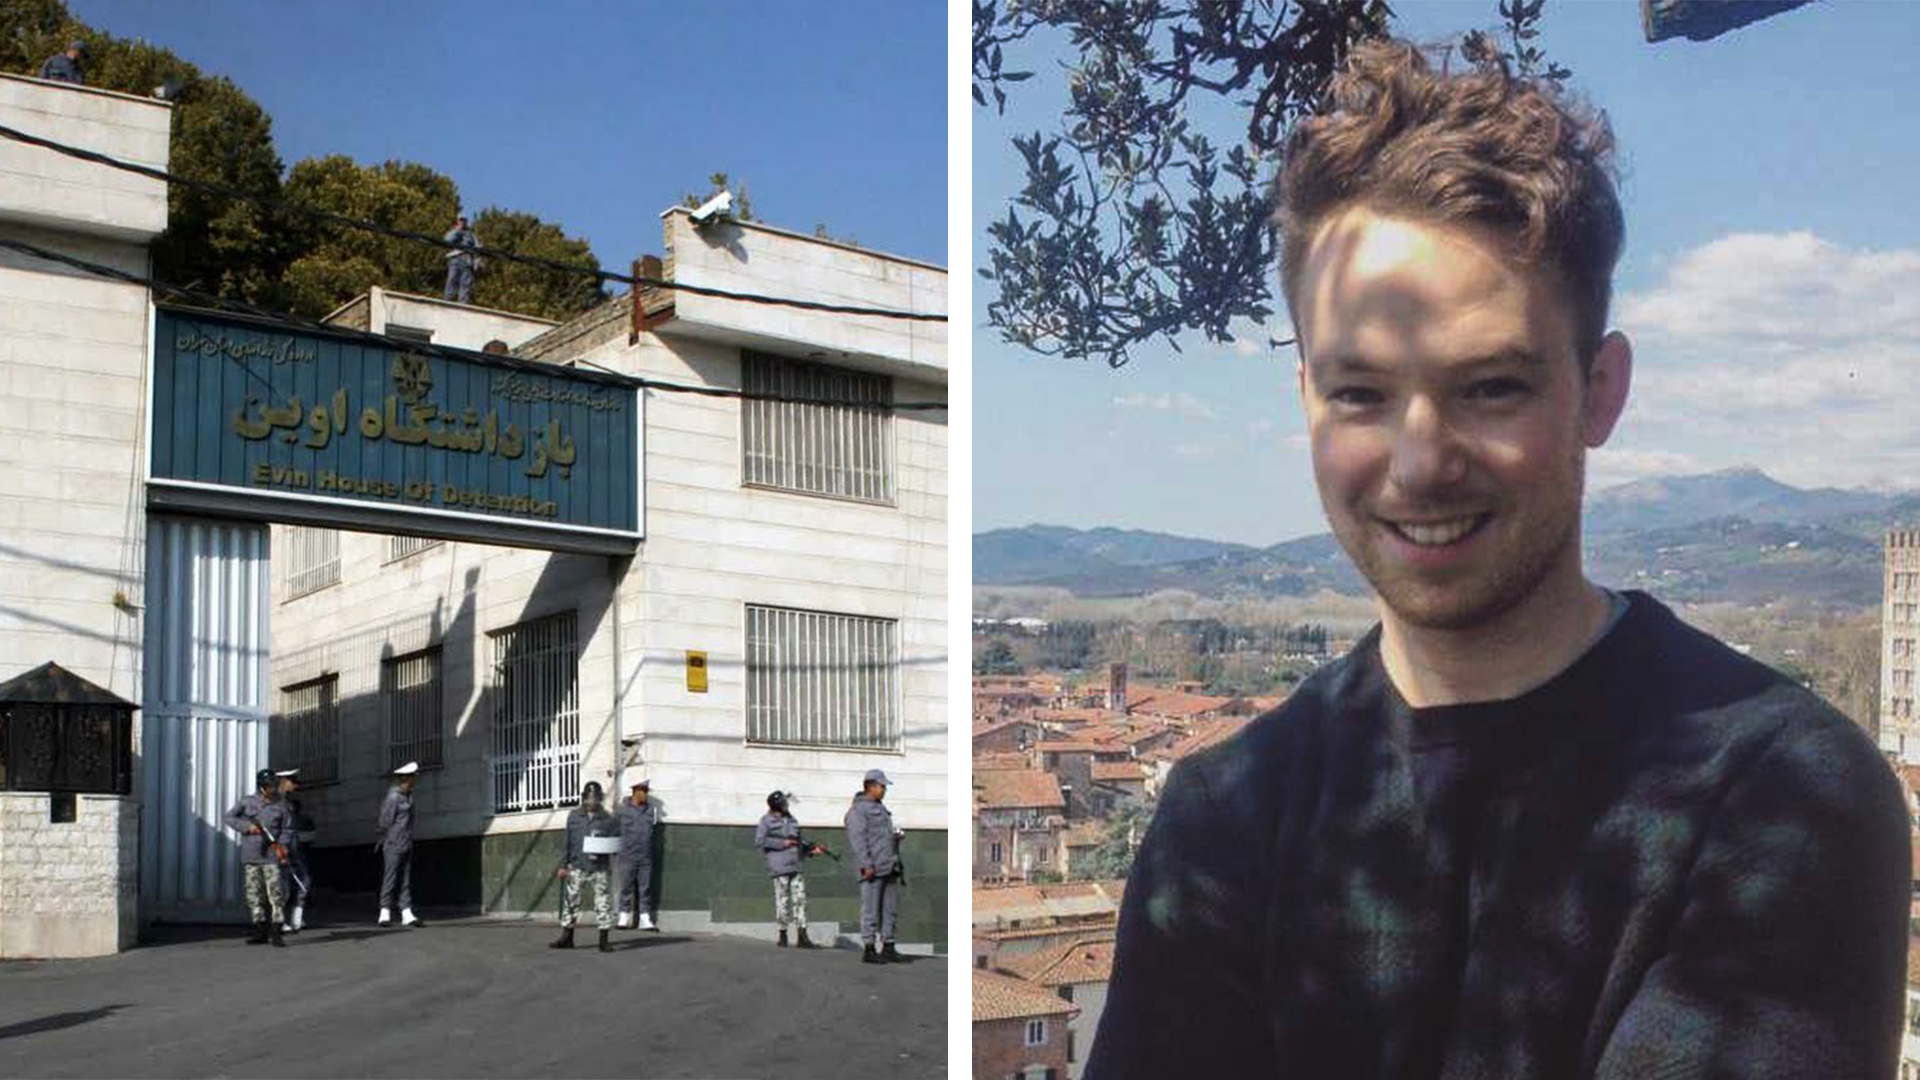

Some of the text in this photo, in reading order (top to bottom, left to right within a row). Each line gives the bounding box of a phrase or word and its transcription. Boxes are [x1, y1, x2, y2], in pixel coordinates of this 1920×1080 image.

[235, 388, 348, 449] اوین
[254, 462, 558, 518] Evin House Of Detention
